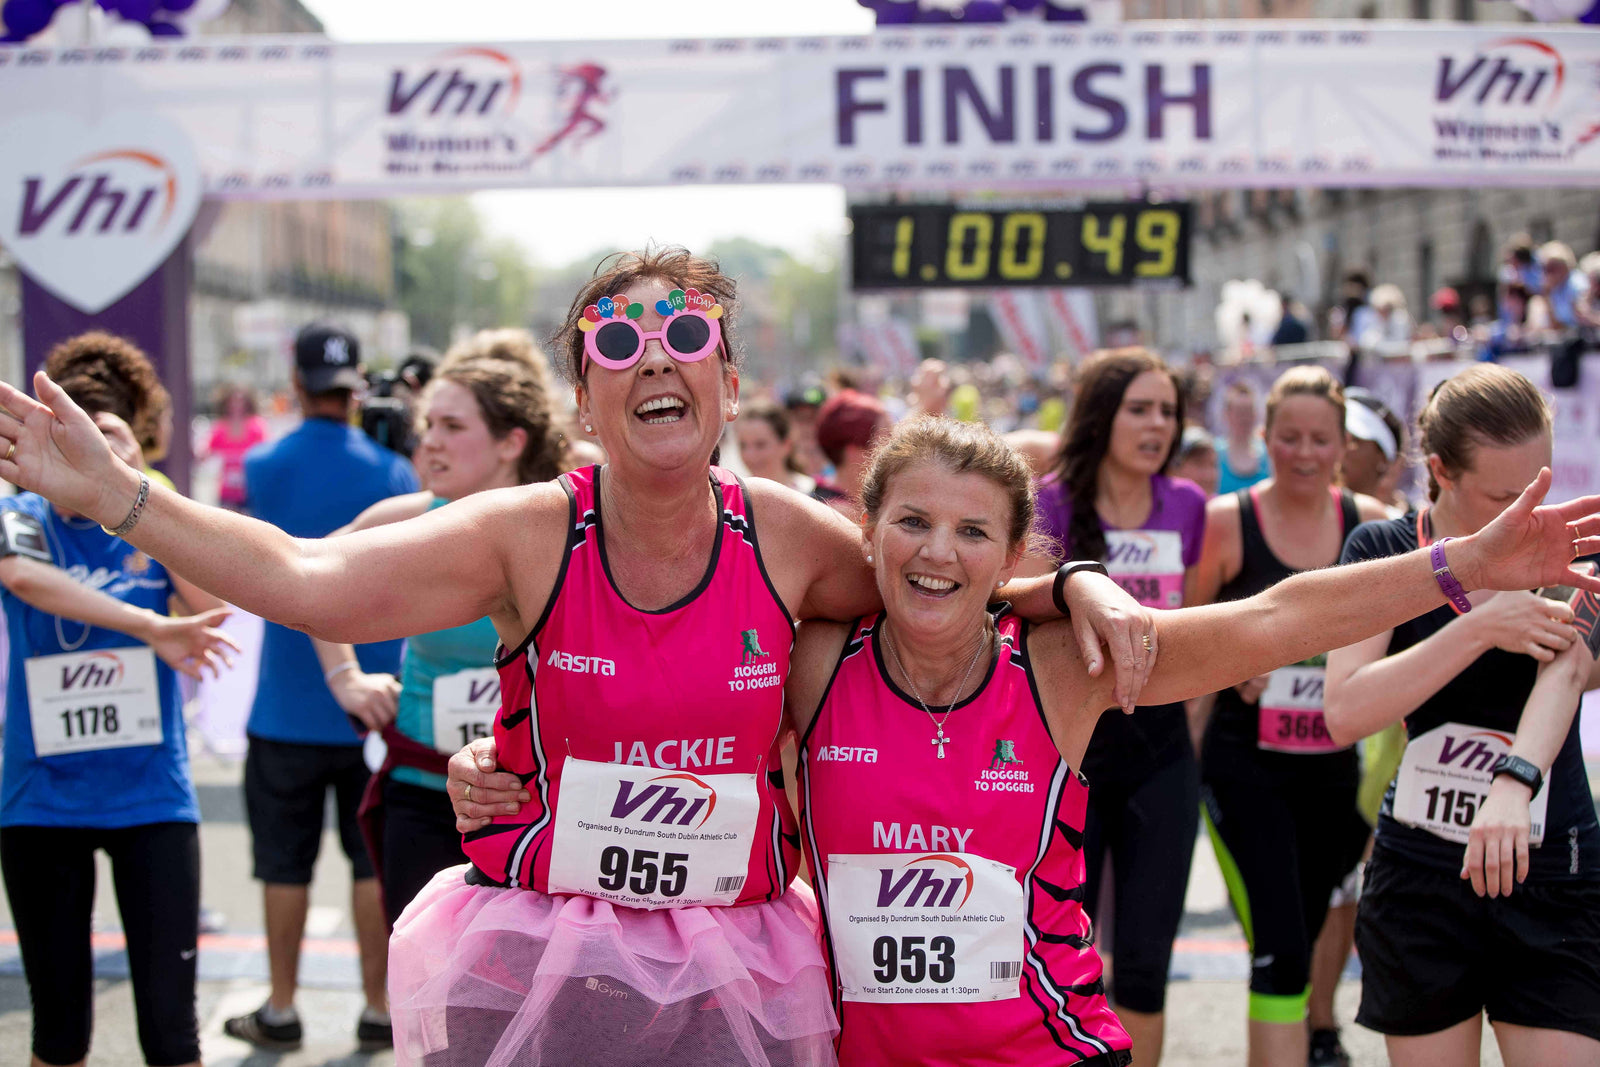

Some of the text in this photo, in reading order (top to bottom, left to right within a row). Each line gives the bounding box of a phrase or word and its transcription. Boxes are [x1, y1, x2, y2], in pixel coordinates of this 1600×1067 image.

[386, 69, 503, 115] Vhi
[1437, 56, 1548, 103] Vhi
[835, 63, 1212, 146] FINISH
[17, 173, 158, 236] Vhi
[592, 294, 716, 317] HAPPY BIRTHDAY
[61, 663, 116, 690] Vhi
[733, 662, 777, 678] SLOGGERS
[728, 675, 781, 692] TO JOGGERS
[60, 704, 120, 738] 1178
[1277, 714, 1332, 739] 366
[458, 723, 494, 747] 15
[608, 736, 736, 770] JACKIE
[974, 780, 1035, 793] TO JOGGERS
[980, 769, 1029, 781] SLOGGERS
[610, 779, 708, 826] Vhi
[577, 820, 612, 832] Organised
[613, 825, 623, 835] By
[624, 827, 655, 838] Dundrum
[657, 830, 676, 840] South
[677, 832, 698, 840] Dublin
[699, 833, 723, 841] Athletic
[872, 821, 974, 853] MARY
[598, 845, 690, 897] 955
[578, 888, 599, 897] Your
[599, 891, 619, 901] Start
[620, 894, 641, 904] Zone
[641, 896, 666, 906] closes
[876, 868, 964, 908] Vhi
[848, 915, 881, 924] Organised
[881, 915, 890, 923] By
[921, 914, 940, 922] South
[941, 914, 962, 922] Dublin
[962, 914, 988, 922] Athletic
[989, 914, 1005, 922] Club
[872, 935, 956, 984] 953
[597, 983, 628, 1000] Gym
[862, 986, 876, 994] Your
[877, 986, 894, 994] Start
[895, 986, 913, 994] Zone
[914, 986, 939, 994] closes
[950, 986, 980, 996] 1:30pm
